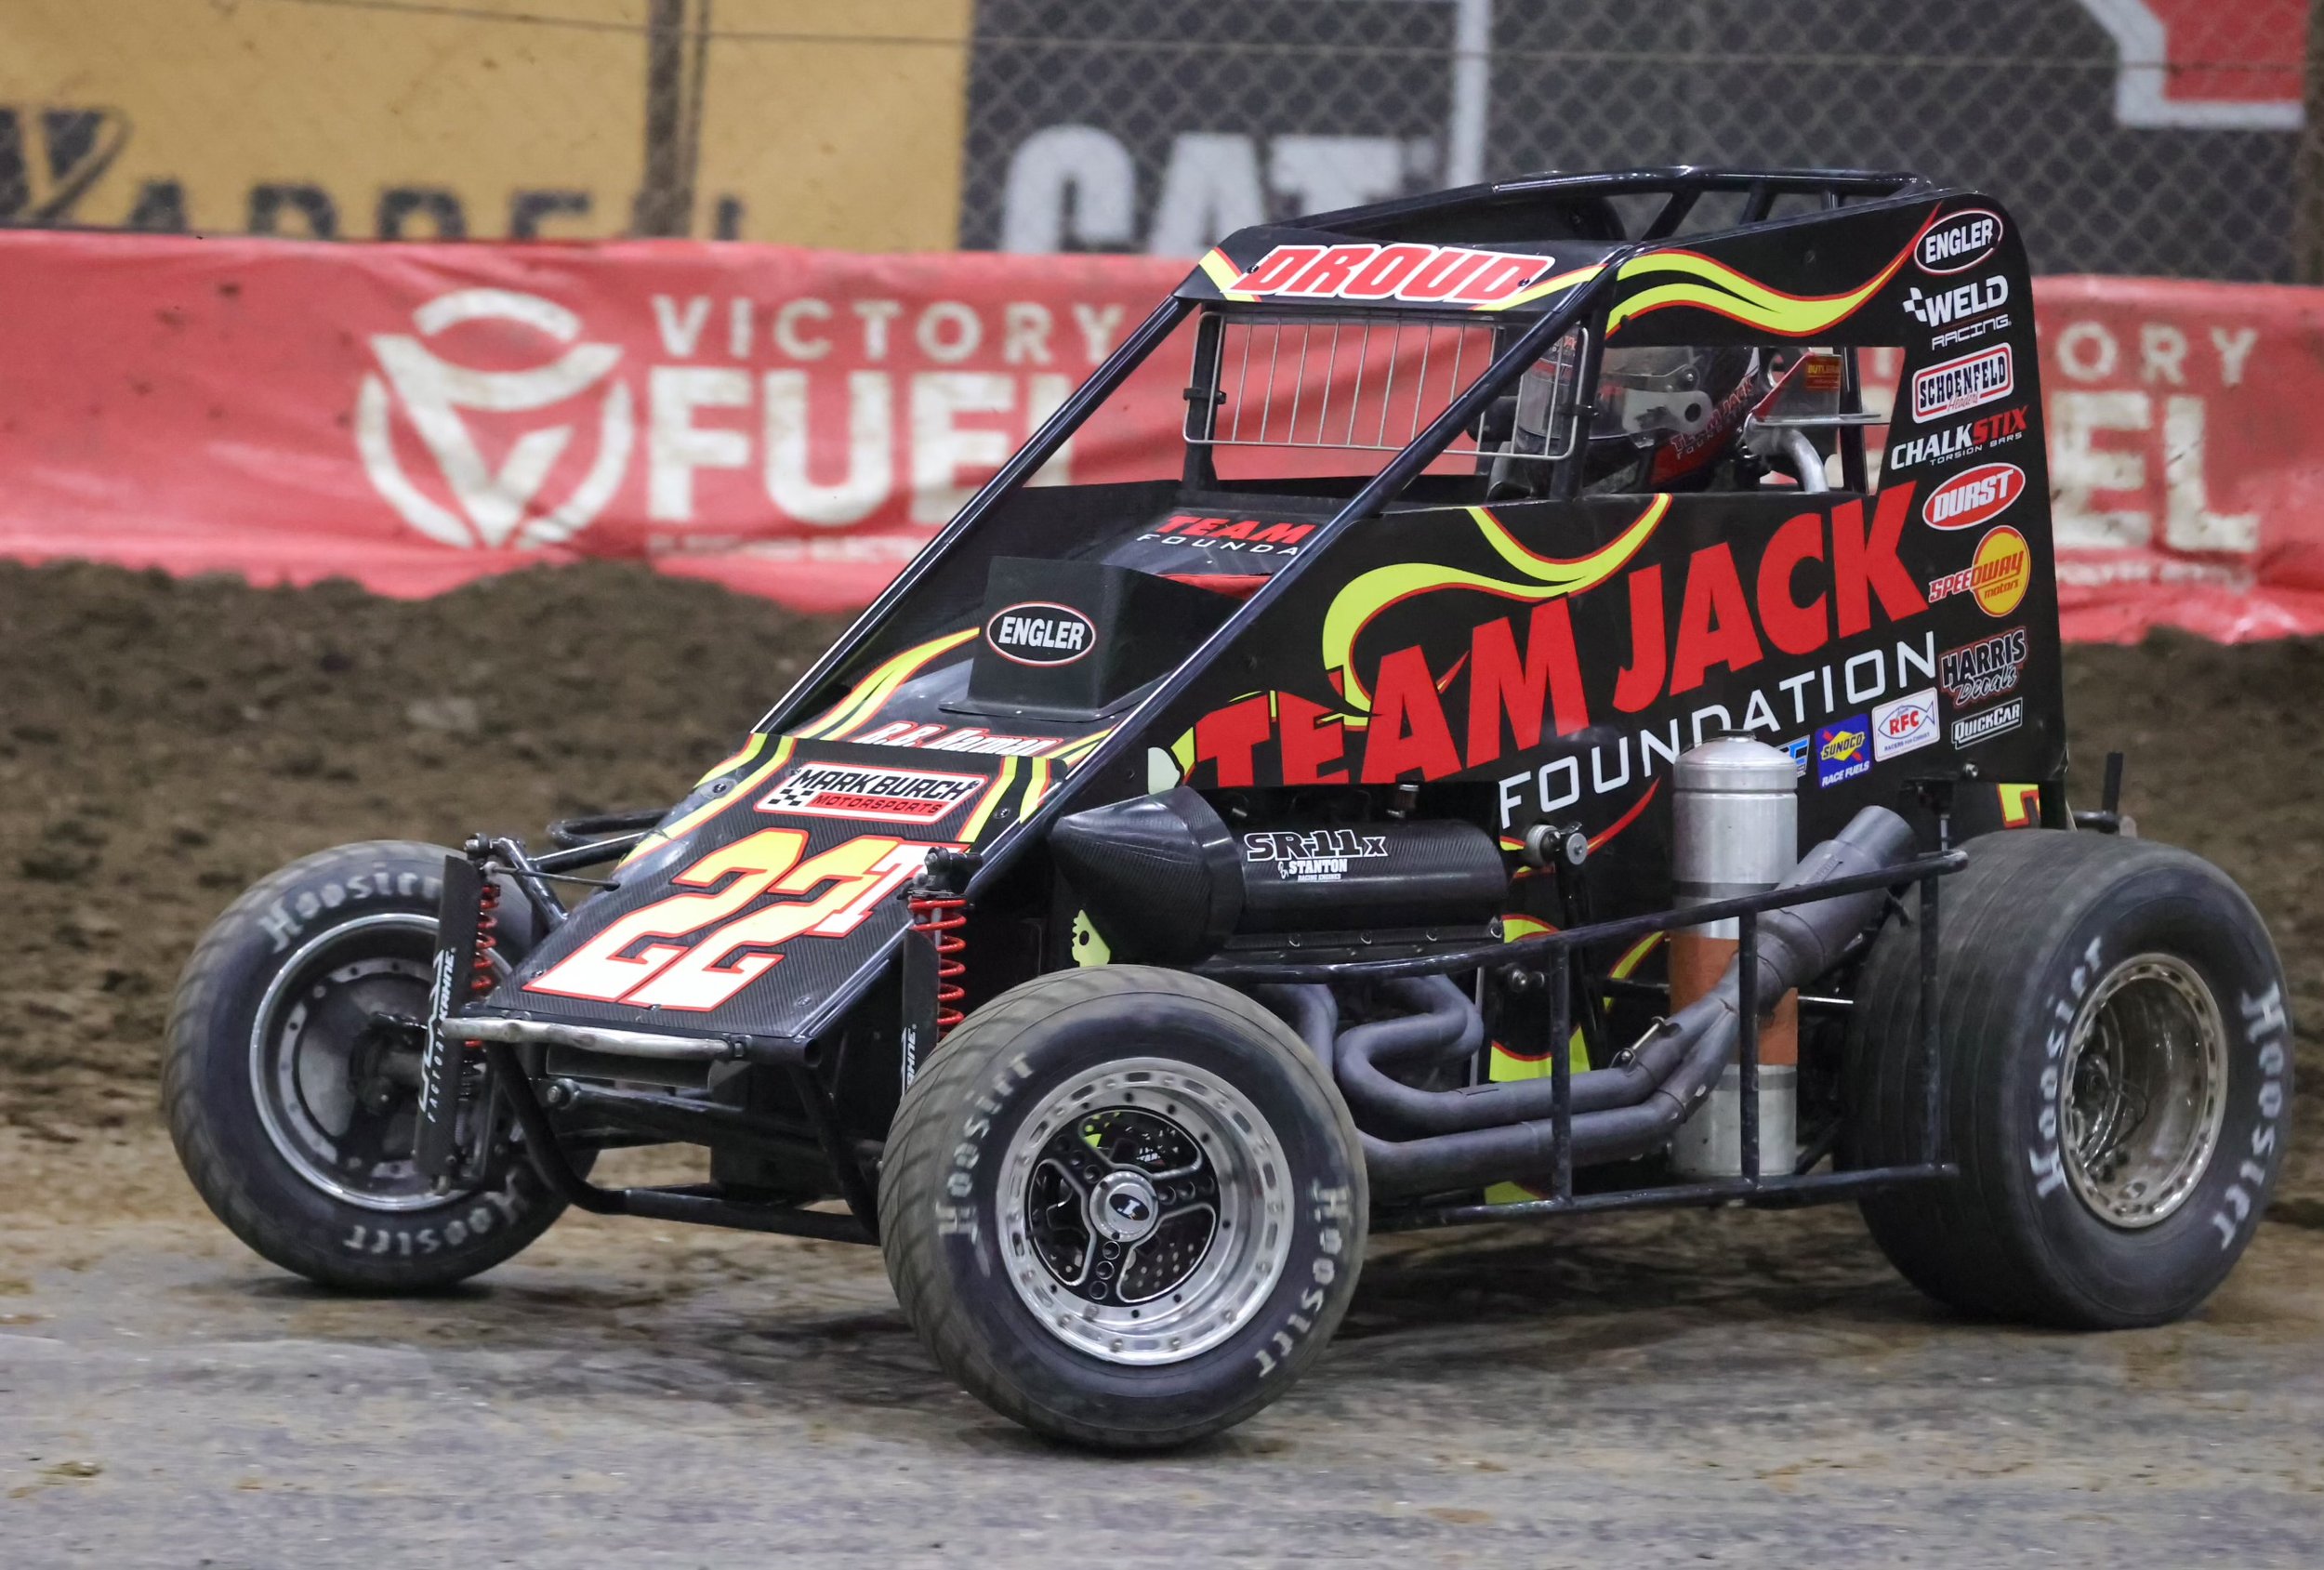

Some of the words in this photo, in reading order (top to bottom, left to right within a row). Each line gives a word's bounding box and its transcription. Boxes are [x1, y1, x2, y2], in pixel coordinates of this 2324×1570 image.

[1925, 218, 1993, 264] ENGLER
[1225, 244, 1551, 303] DROUD
[1925, 275, 2009, 327] WELD
[654, 295, 1124, 366] VICTORY
[1932, 314, 2009, 350] RACING
[1920, 356, 2006, 408] SCHOENFELD
[1930, 445, 1983, 466] TORSION
[1990, 432, 2023, 447] BARS
[2051, 390, 2259, 554] EL
[1933, 468, 2014, 523] DURST
[1136, 534, 1300, 556] FOUNDA
[1155, 515, 1316, 544] TEAM
[1928, 549, 2024, 602] SPEEDWAY
[1984, 578, 2019, 599] motors
[998, 616, 1086, 650] ENGLER
[1194, 597, 1590, 788] TEAM
[1613, 481, 1929, 714] JACK
[1941, 628, 2027, 689] HARRIS
[1953, 664, 2017, 706] Decals
[1889, 710, 1920, 735] RFC
[1822, 731, 1865, 759] SUNOCO
[1884, 741, 1904, 751] RACERS
[1822, 770, 1844, 787] RACE
[1845, 760, 1870, 778] FUELS
[812, 796, 943, 813] MOTORSPORTS
[1288, 858, 1348, 875] STANTON
[906, 1027, 917, 1088] AHNE
